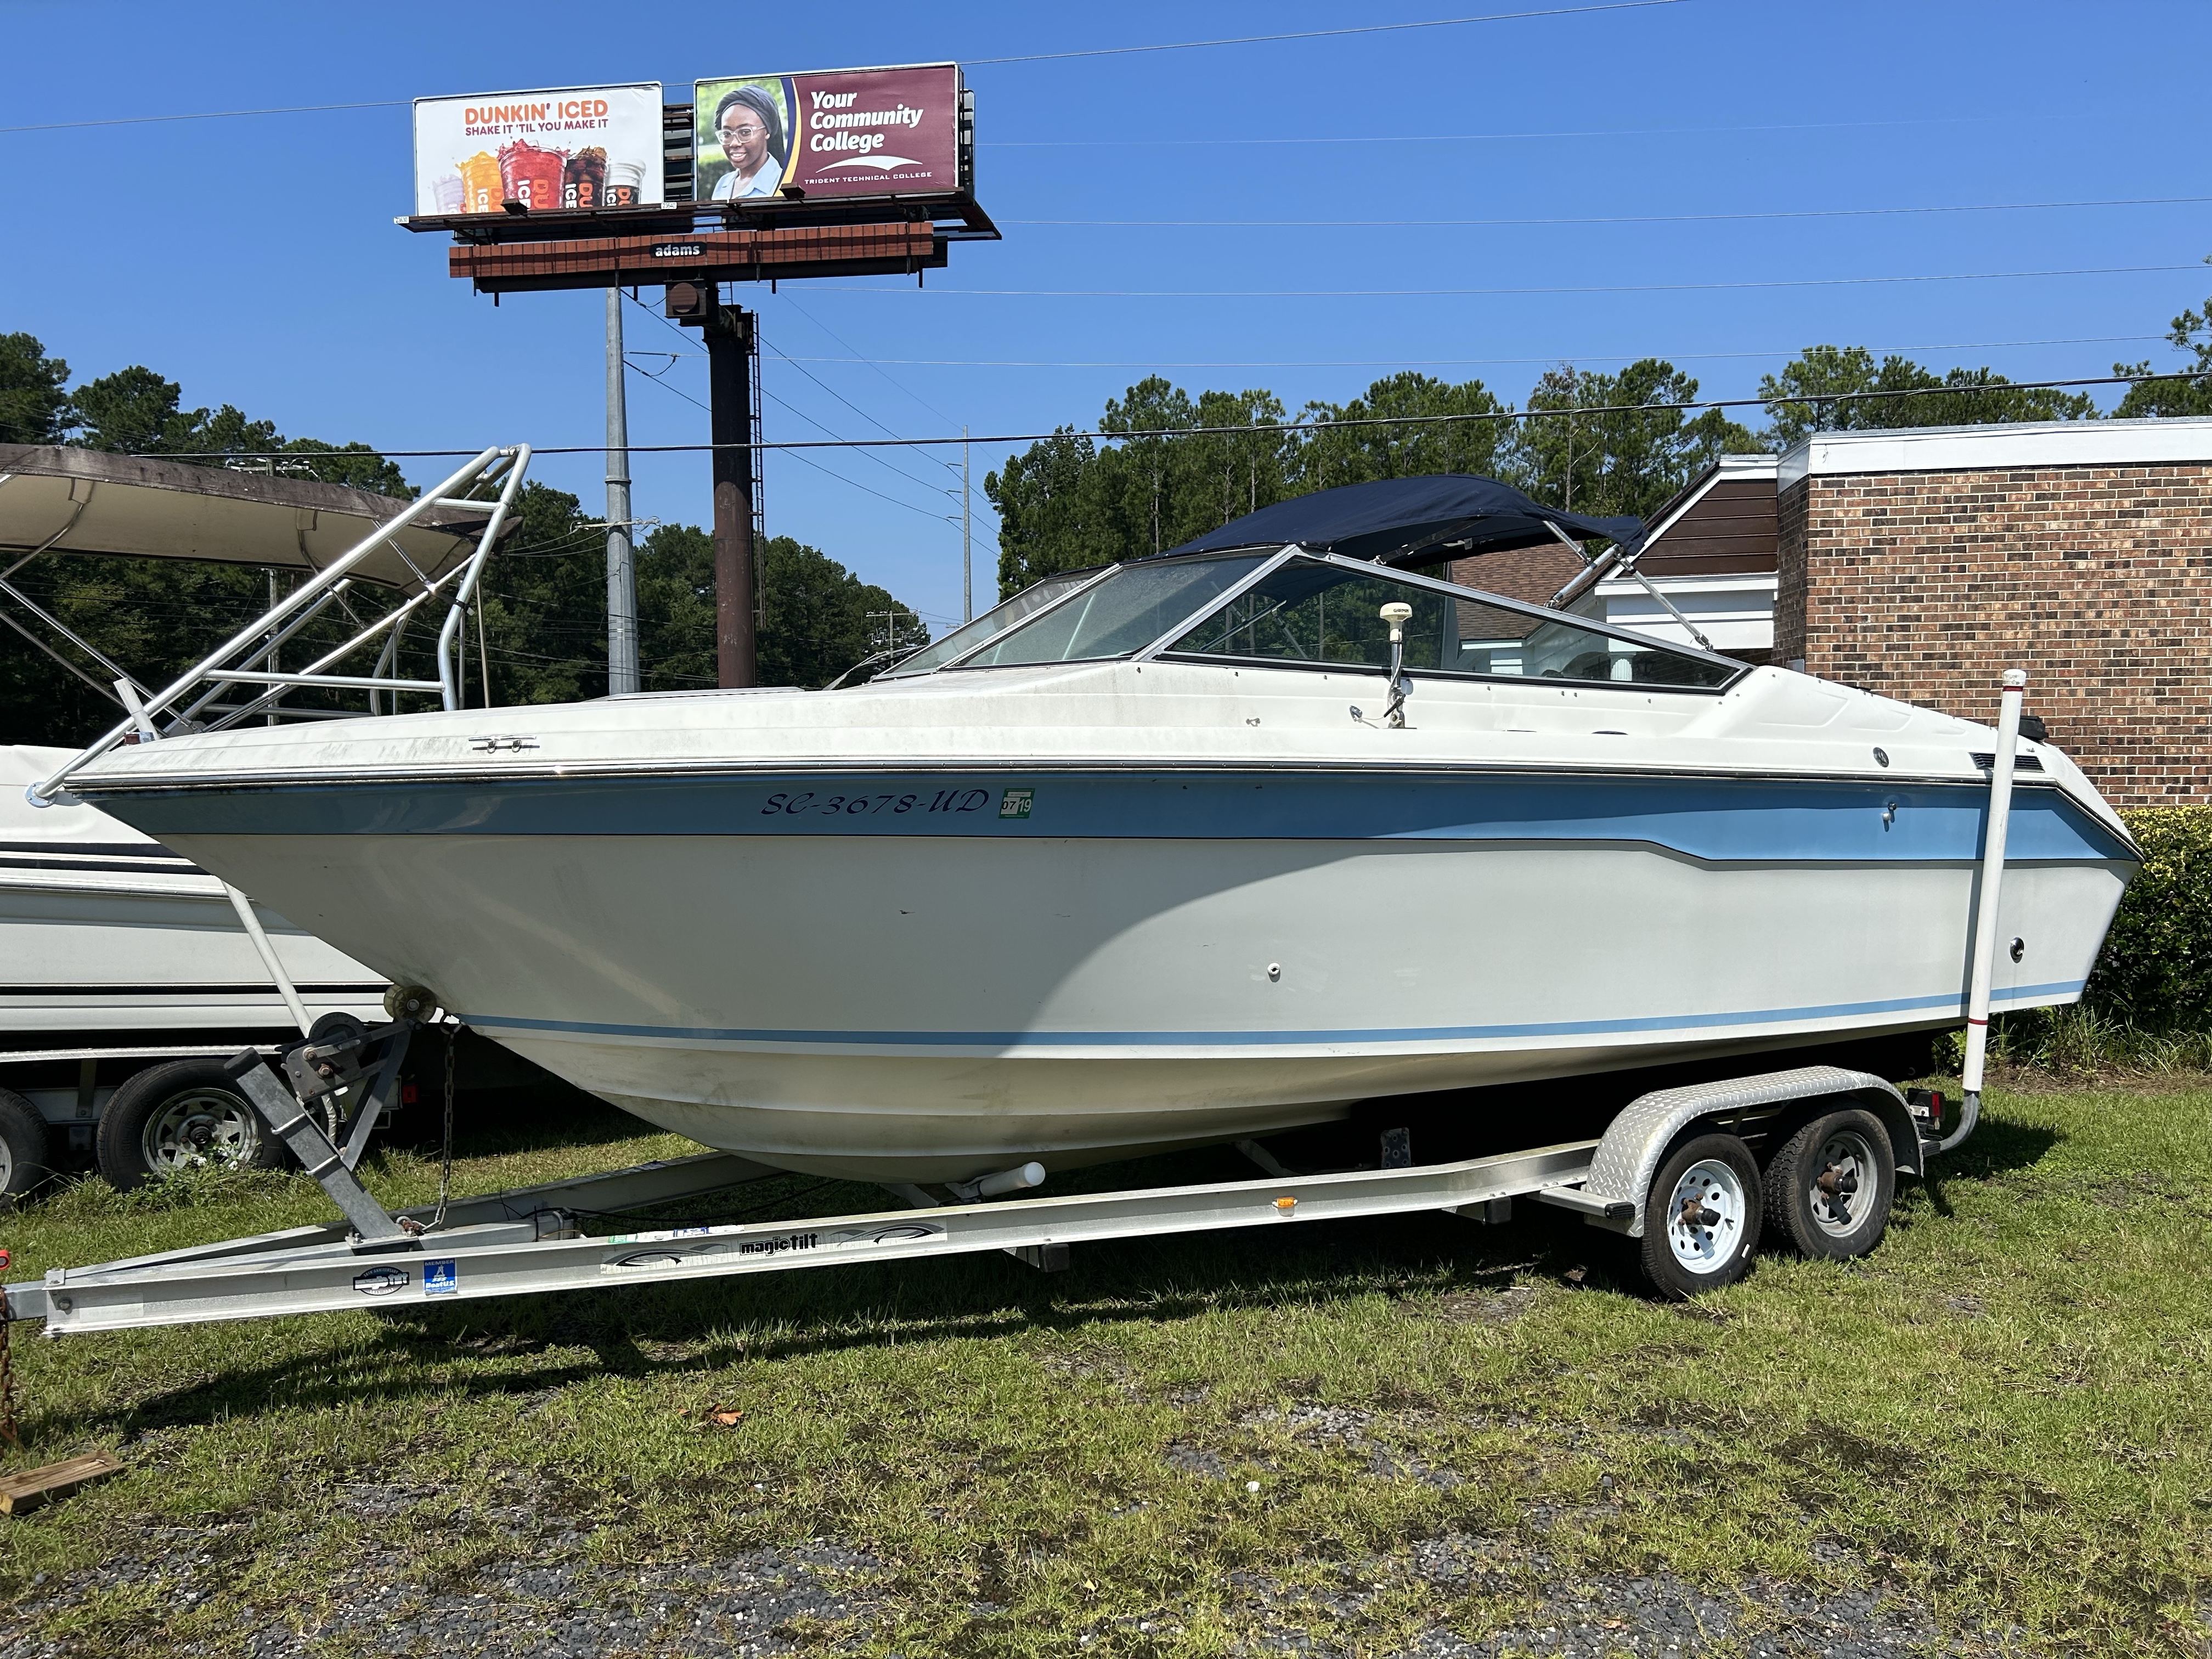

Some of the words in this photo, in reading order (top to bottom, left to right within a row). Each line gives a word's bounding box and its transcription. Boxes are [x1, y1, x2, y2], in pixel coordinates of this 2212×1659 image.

[810, 91, 857, 109] Your
[465, 103, 551, 125] DUNKIN'
[557, 99, 608, 120] ICED
[810, 103, 924, 129] Community
[465, 126, 500, 136] SHAKE
[503, 125, 513, 134] IT
[516, 123, 536, 133] 'TIL
[538, 121, 561, 132] YOU
[564, 120, 595, 130] MAKE
[598, 119, 609, 128] IT
[810, 131, 885, 154] College
[655, 244, 700, 257] adams
[760, 789, 989, 815] SC-3678-UD
[1002, 801, 1017, 810] 07
[1019, 799, 1032, 812] 19
